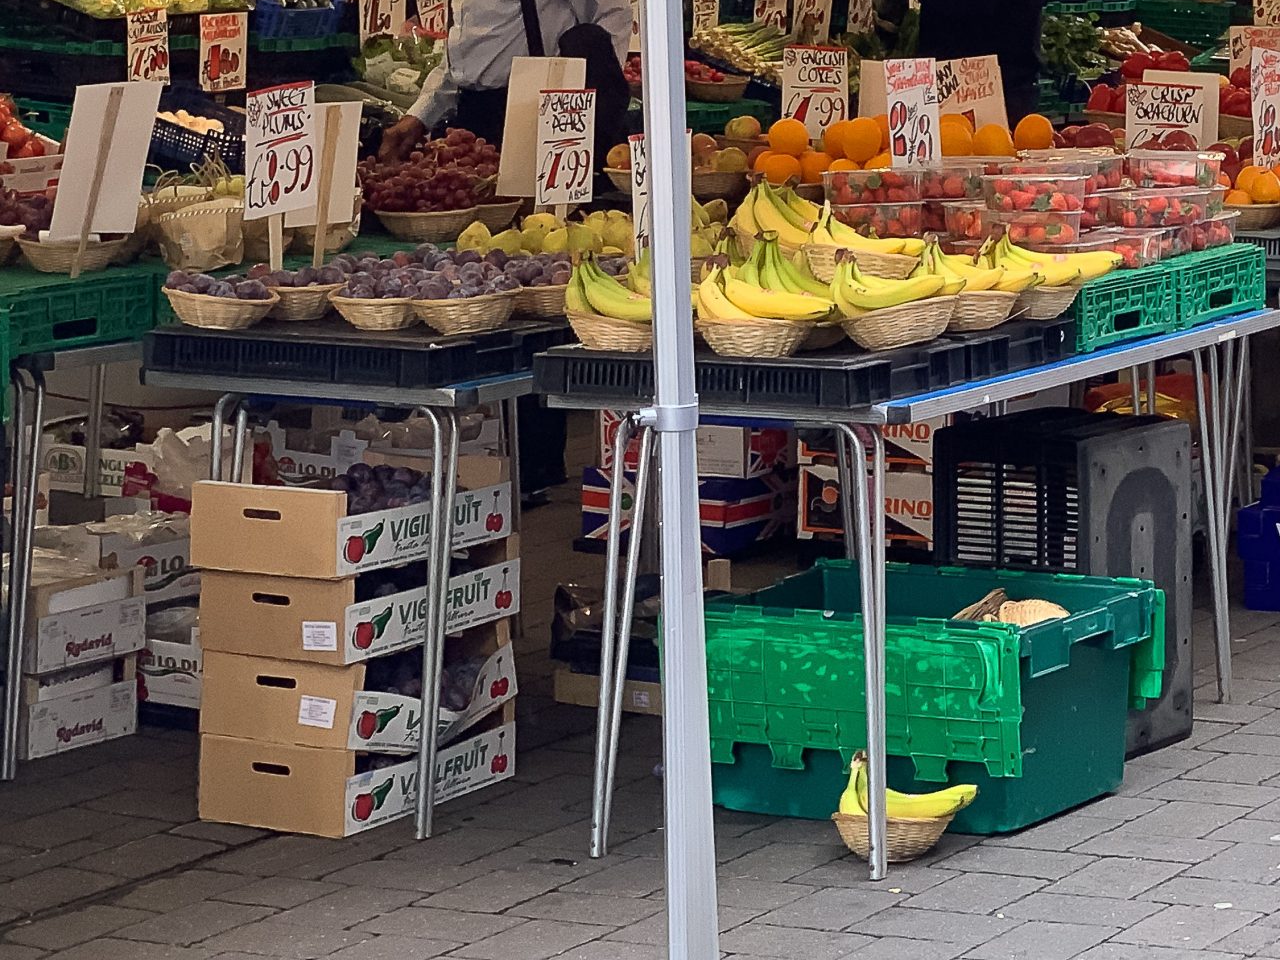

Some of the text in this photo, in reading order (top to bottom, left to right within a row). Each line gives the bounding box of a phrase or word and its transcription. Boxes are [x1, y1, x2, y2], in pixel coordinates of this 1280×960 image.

[801, 50, 845, 66] ENGLISH
[798, 66, 842, 85] COXES
[266, 87, 306, 111] SWEET
[551, 93, 594, 112] ENGLISH
[1150, 86, 1197, 103] CRISP
[262, 110, 306, 137] PLUMS
[552, 112, 587, 135] PEARS
[1135, 102, 1204, 124] BRAEBURN
[537, 148, 591, 204] £1.99
